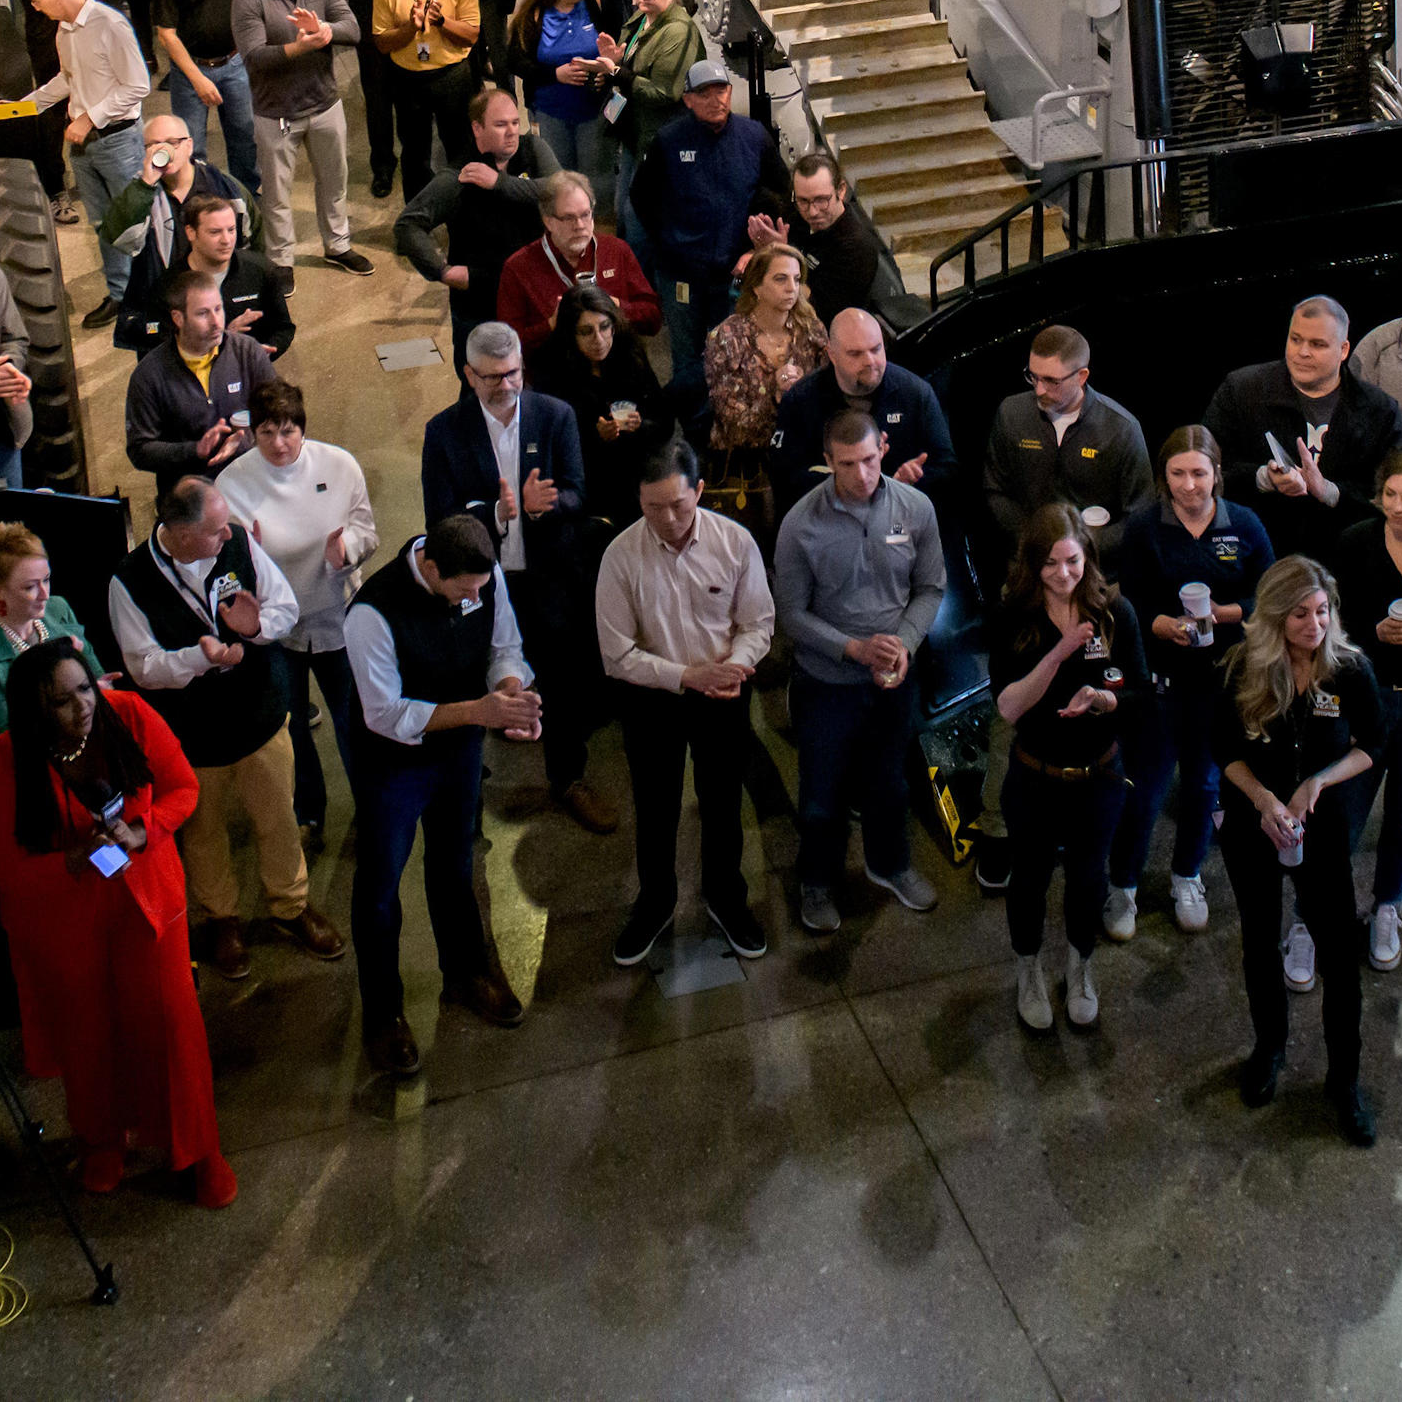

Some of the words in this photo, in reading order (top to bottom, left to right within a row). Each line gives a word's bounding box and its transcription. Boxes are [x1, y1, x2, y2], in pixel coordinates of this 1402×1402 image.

[679, 150, 697, 162] CAT
[602, 269, 616, 279] CAT
[887, 413, 903, 423] CAT
[1081, 447, 1099, 458] CAT
[1315, 694, 1340, 704] 100
